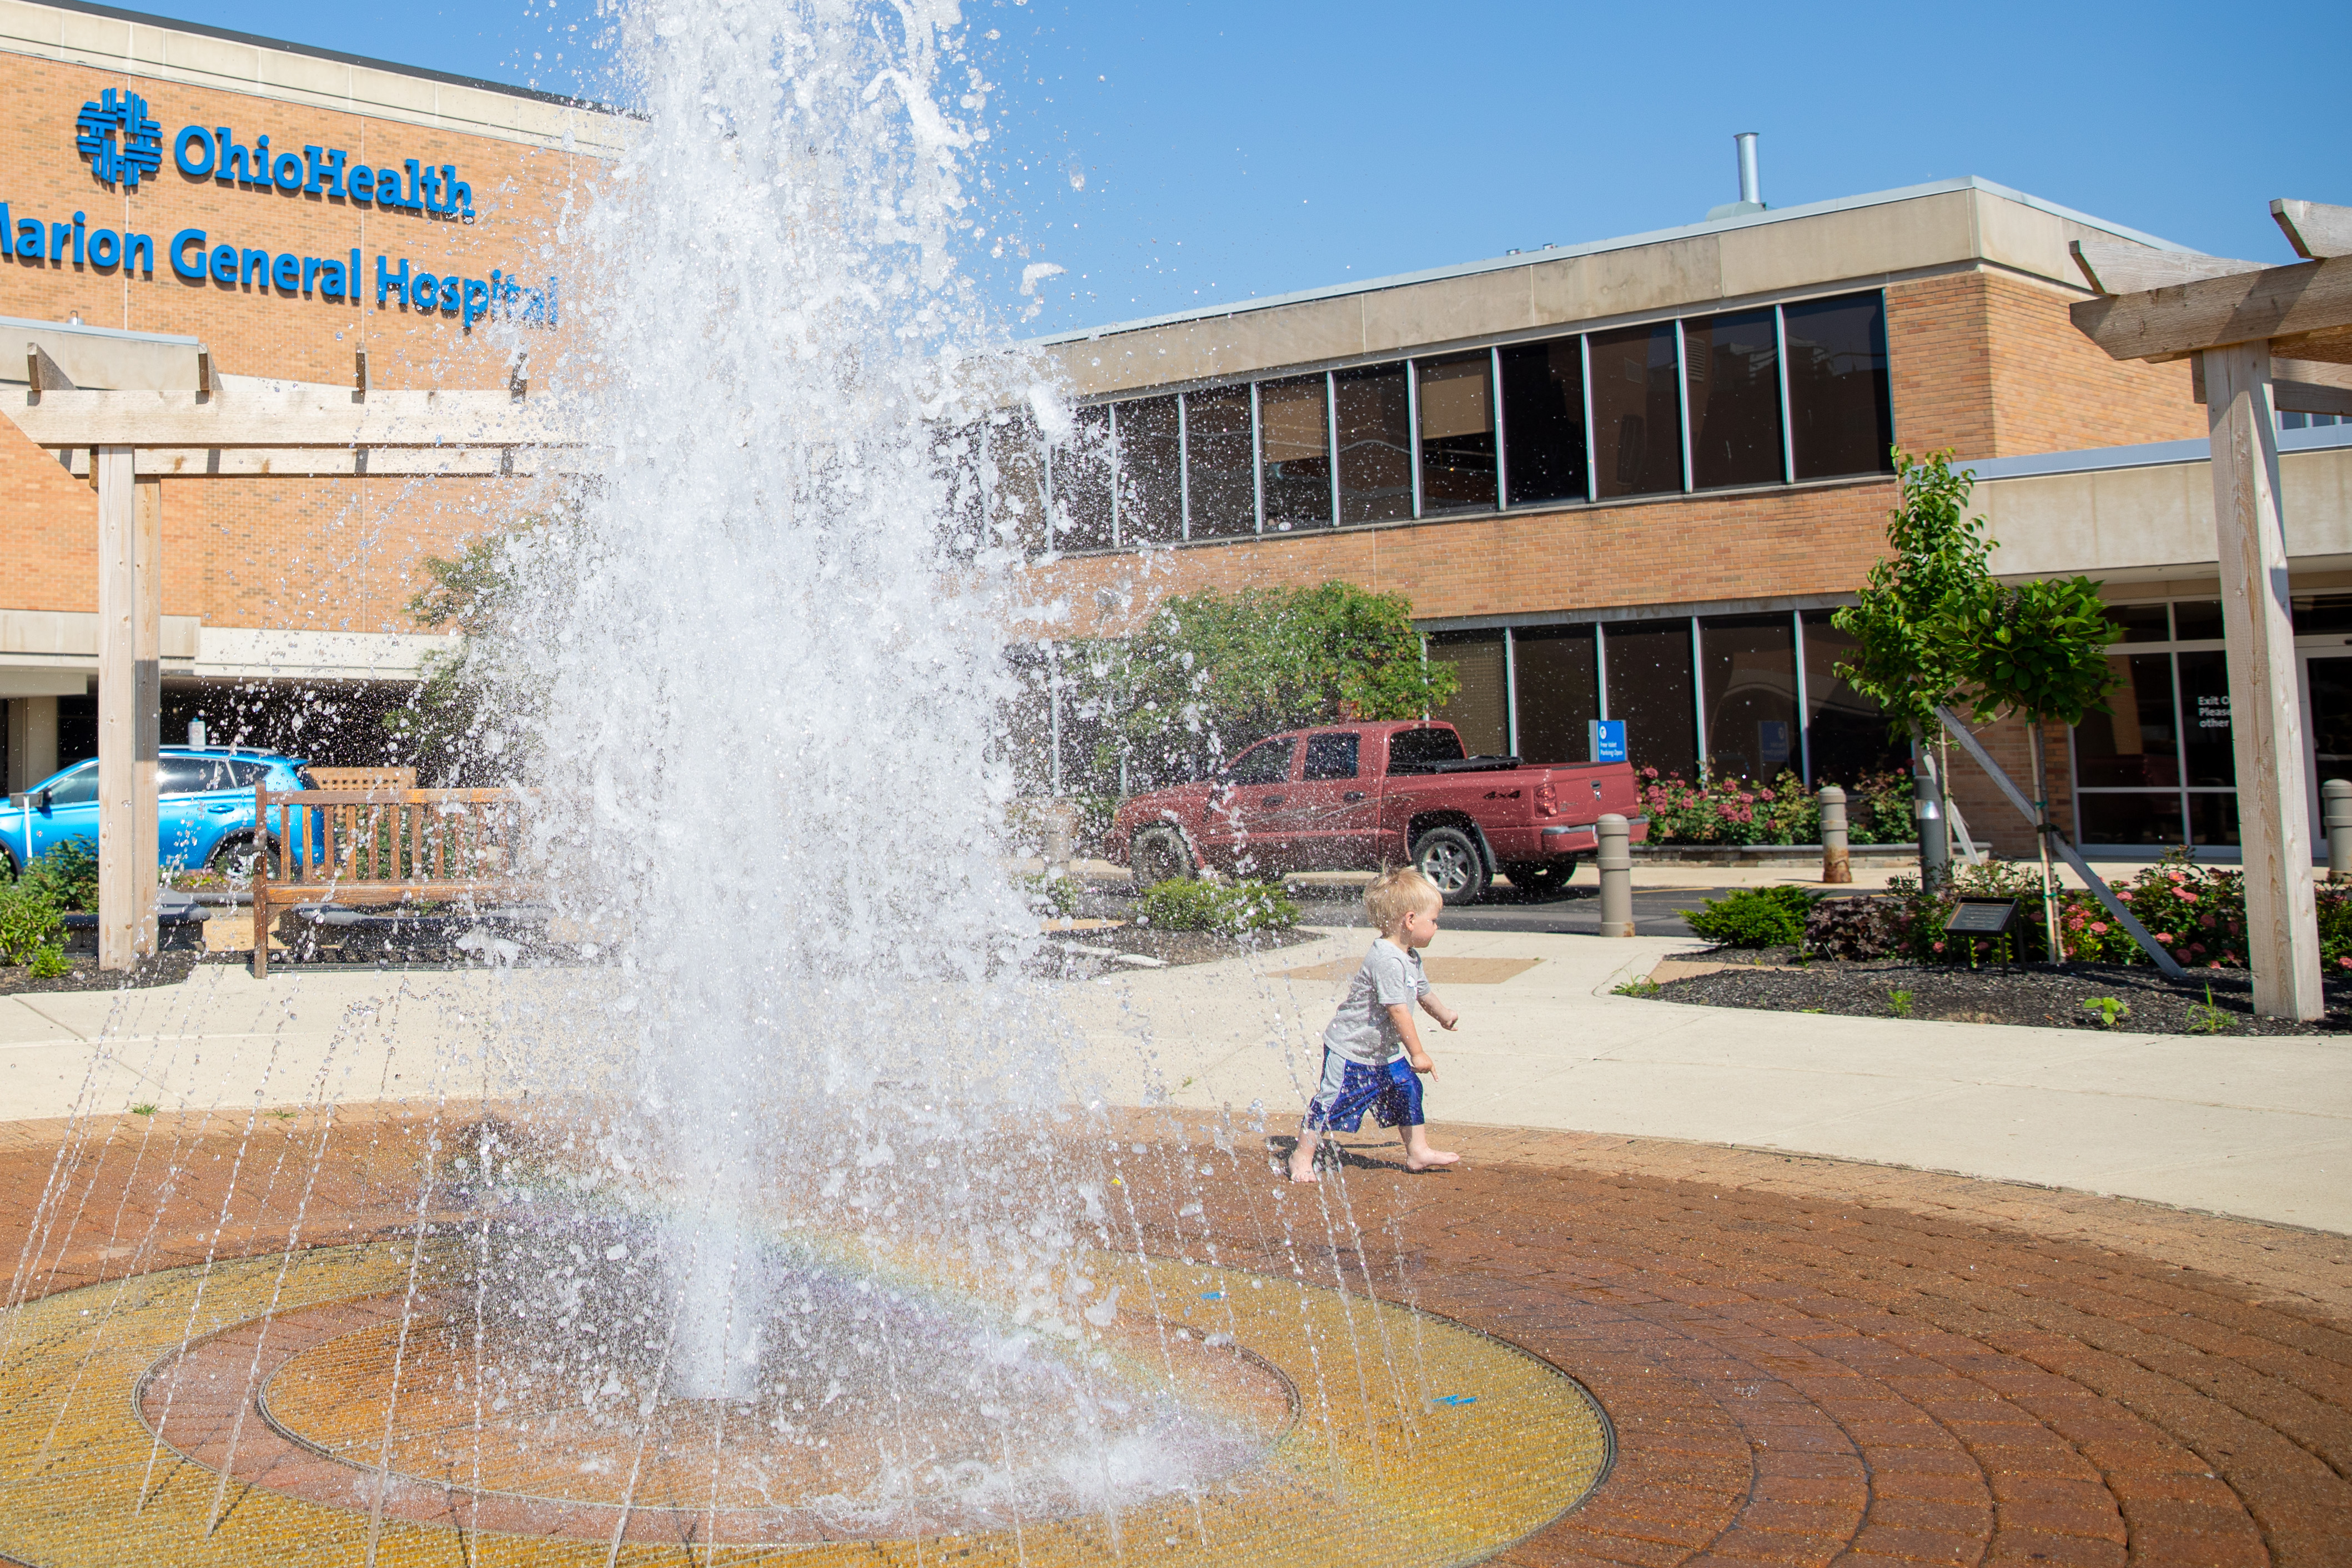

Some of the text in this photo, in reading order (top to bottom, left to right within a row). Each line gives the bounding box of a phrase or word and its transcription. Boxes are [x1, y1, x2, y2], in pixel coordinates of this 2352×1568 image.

[175, 125, 476, 217] OhioHealth
[170, 229, 361, 298] General
[377, 255, 558, 328] Hospital
[2198, 696, 2219, 705] Exit
[2199, 718, 2230, 727] other
[1482, 790, 1521, 801] 4x4
